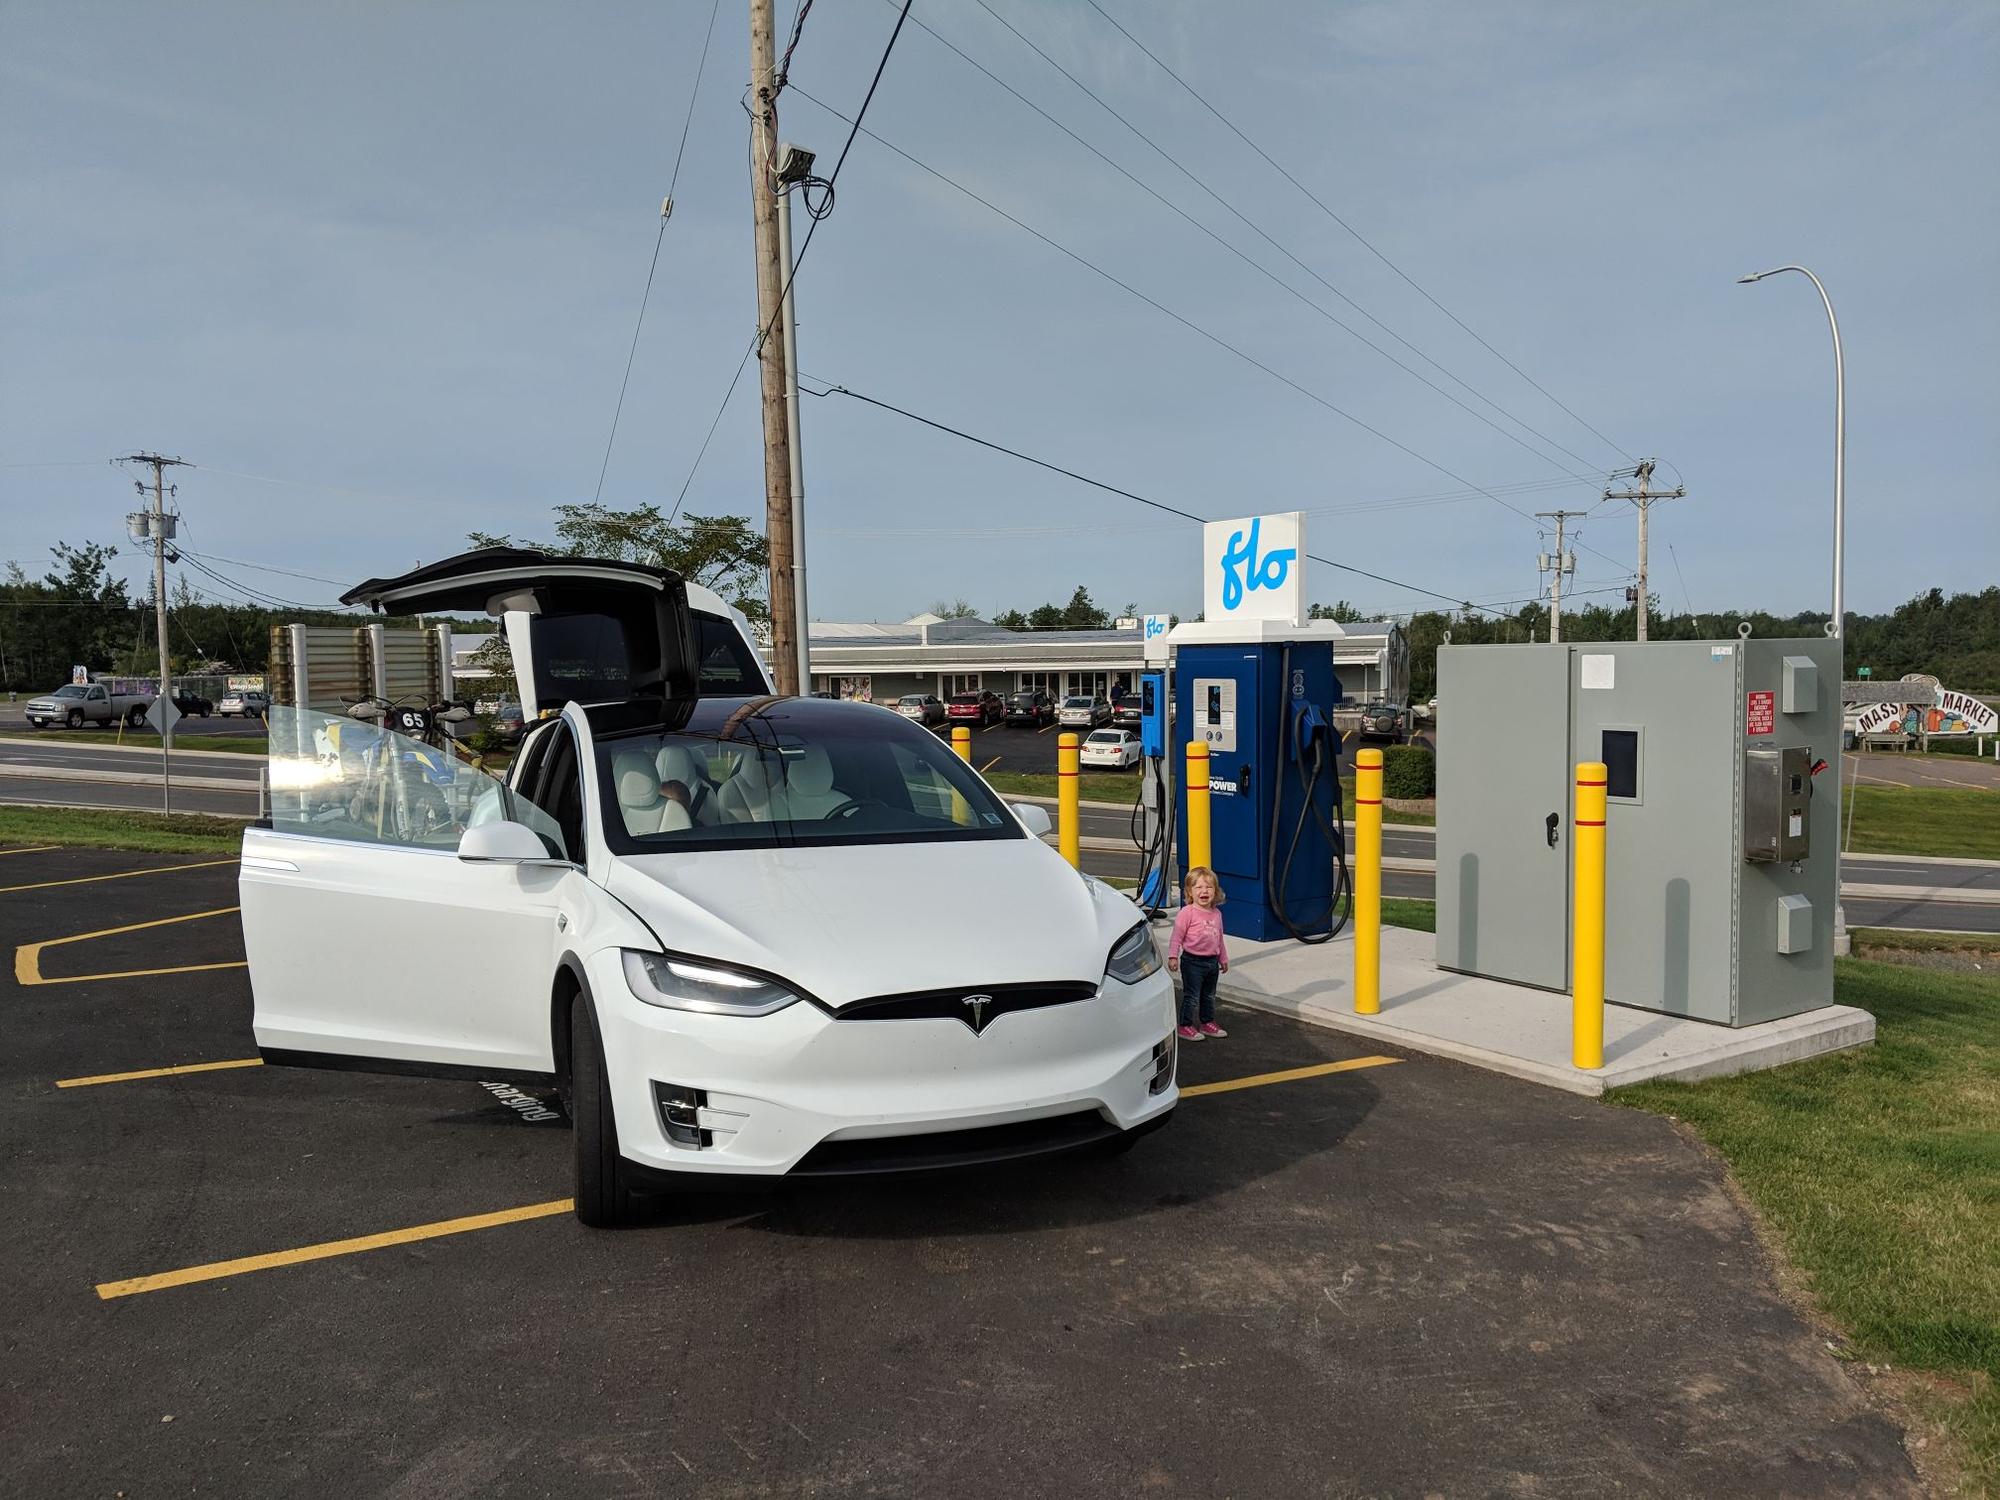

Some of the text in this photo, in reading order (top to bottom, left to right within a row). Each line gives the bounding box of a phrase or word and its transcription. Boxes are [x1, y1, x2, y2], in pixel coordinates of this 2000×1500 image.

[1221, 517, 1297, 611] flo
[1146, 616, 1165, 639] flo
[402, 712, 425, 728] 65
[1942, 692, 1995, 727] MARKET
[1208, 780, 1237, 792] POWER
